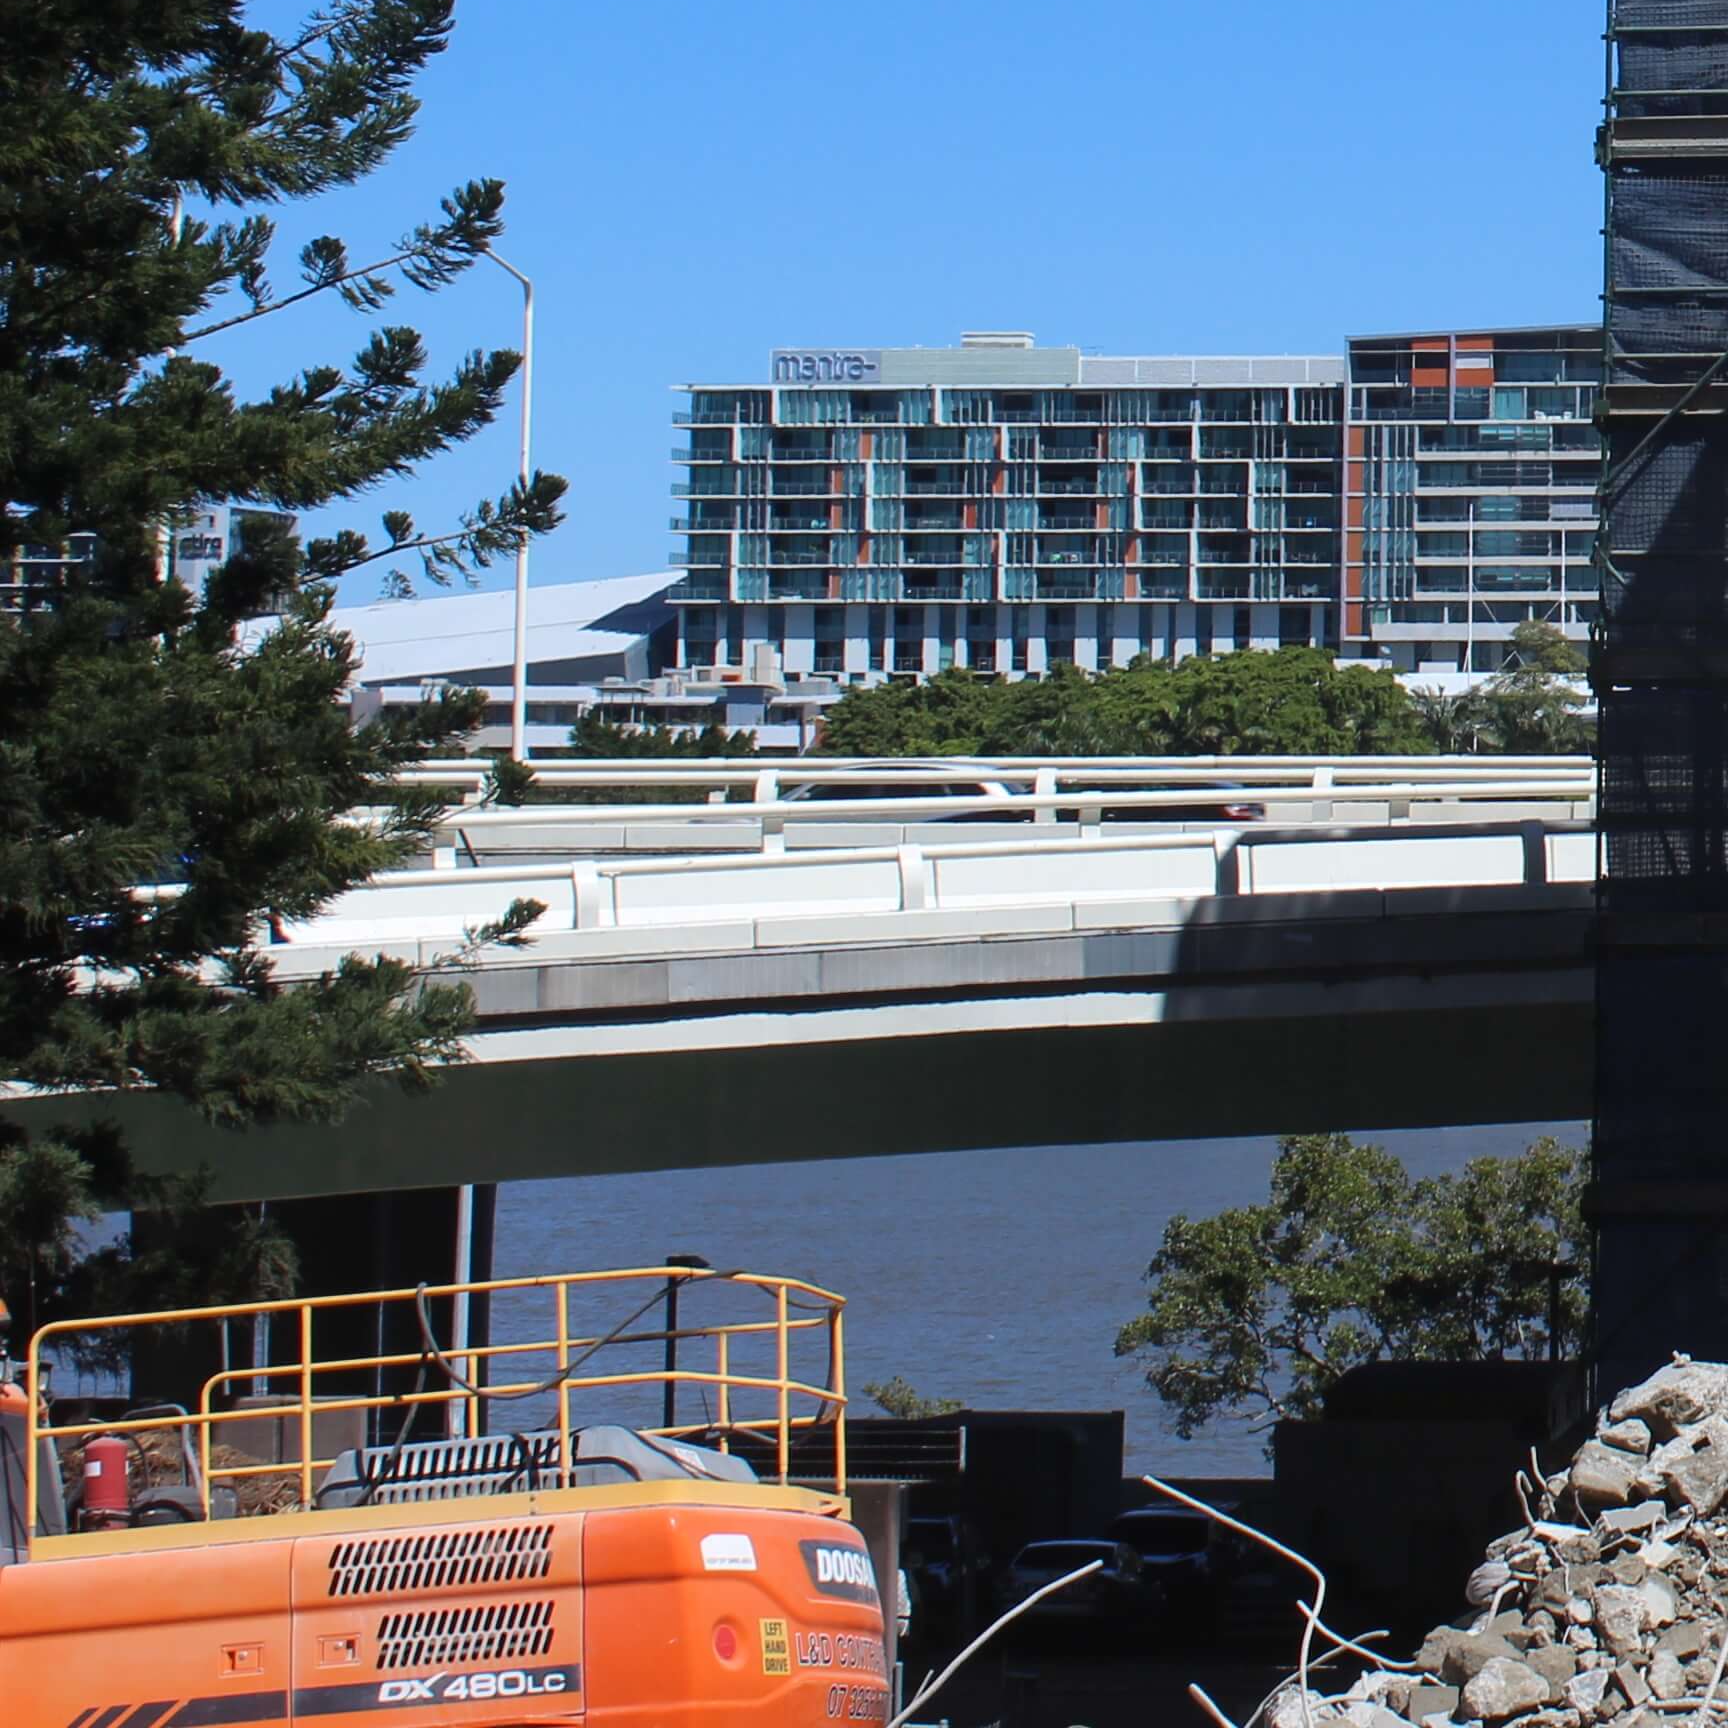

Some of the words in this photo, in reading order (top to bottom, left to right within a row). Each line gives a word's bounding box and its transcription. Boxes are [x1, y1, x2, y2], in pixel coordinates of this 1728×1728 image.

[775, 352, 876, 380] mantra
[764, 1622, 782, 1636] LEFT
[764, 1640, 786, 1654] HAND
[795, 1632, 833, 1666] L&D
[765, 1658, 788, 1673] DRIVE
[378, 1672, 448, 1703] DX
[443, 1671, 567, 1700] 480LC
[827, 1683, 848, 1718] 07
